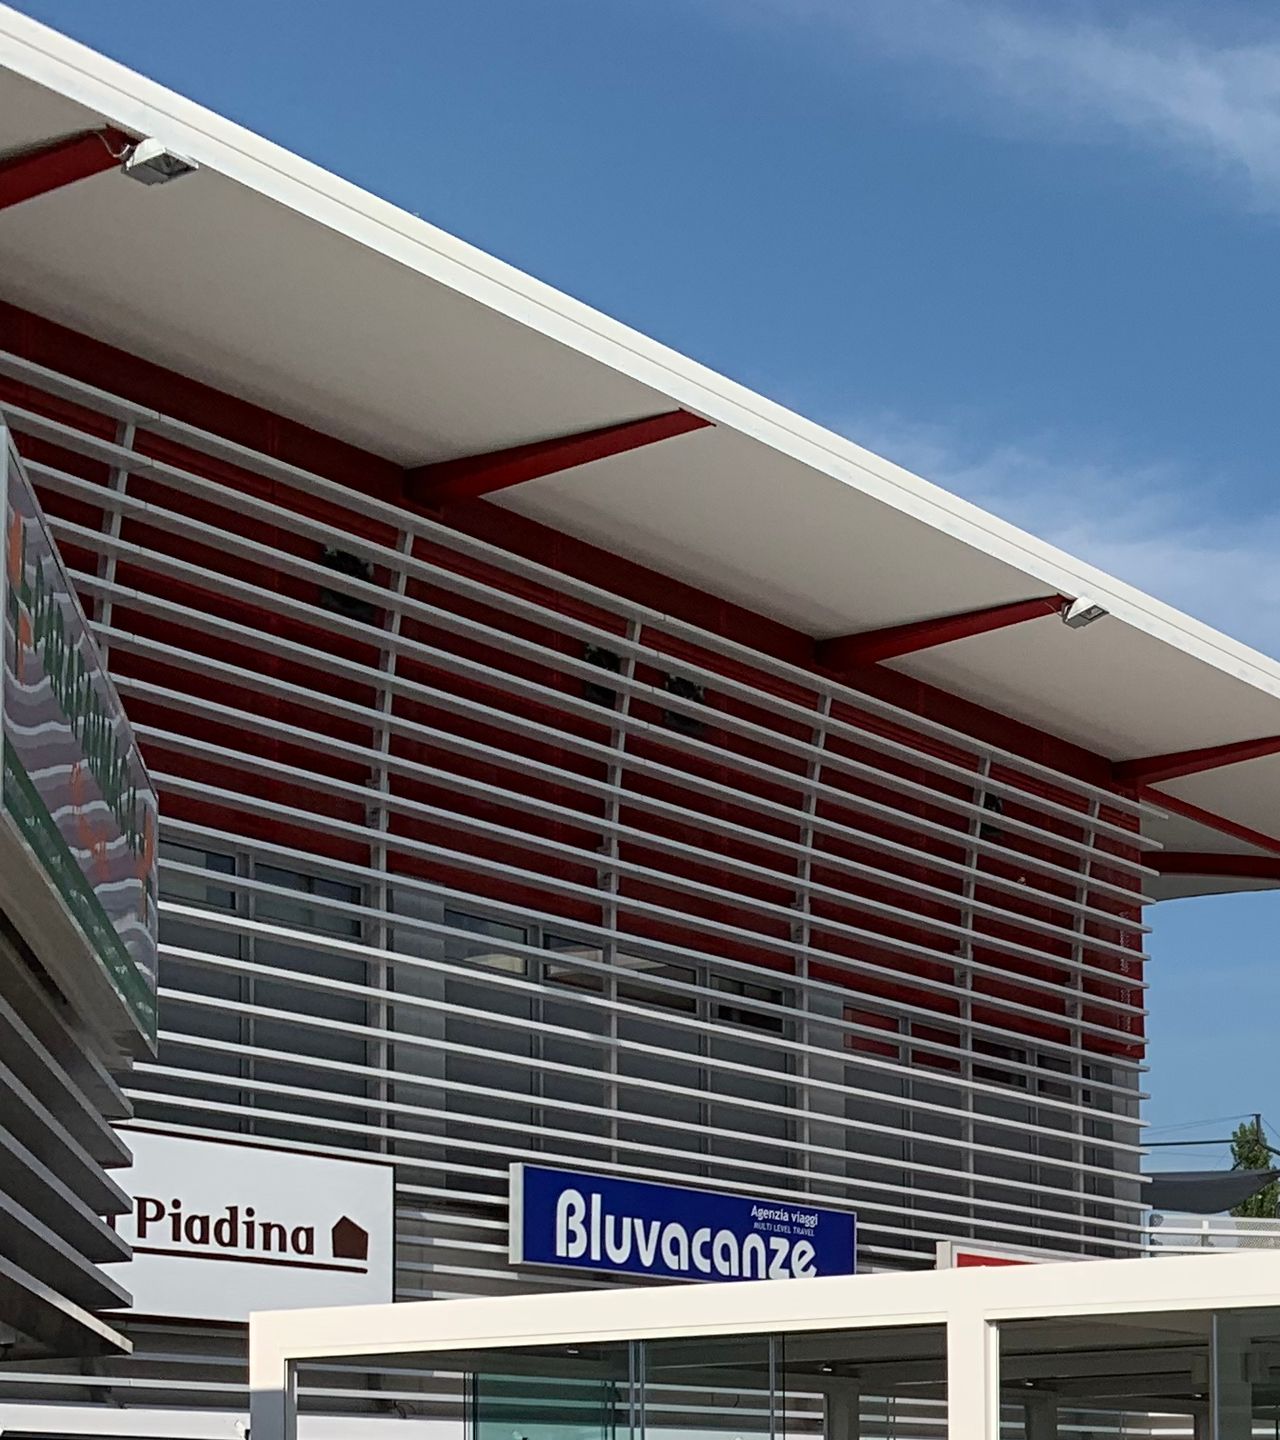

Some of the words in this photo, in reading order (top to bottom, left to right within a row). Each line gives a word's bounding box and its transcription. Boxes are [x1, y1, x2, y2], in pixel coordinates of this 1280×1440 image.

[133, 1196, 314, 1255] Piadina
[556, 1188, 817, 1280] Bluvacanze
[751, 1205, 789, 1221] Agenzia
[791, 1211, 818, 1228] viaggi
[753, 1222, 772, 1231] MULTI
[773, 1224, 791, 1234] LEVEL
[793, 1226, 815, 1237] TRAVEL
